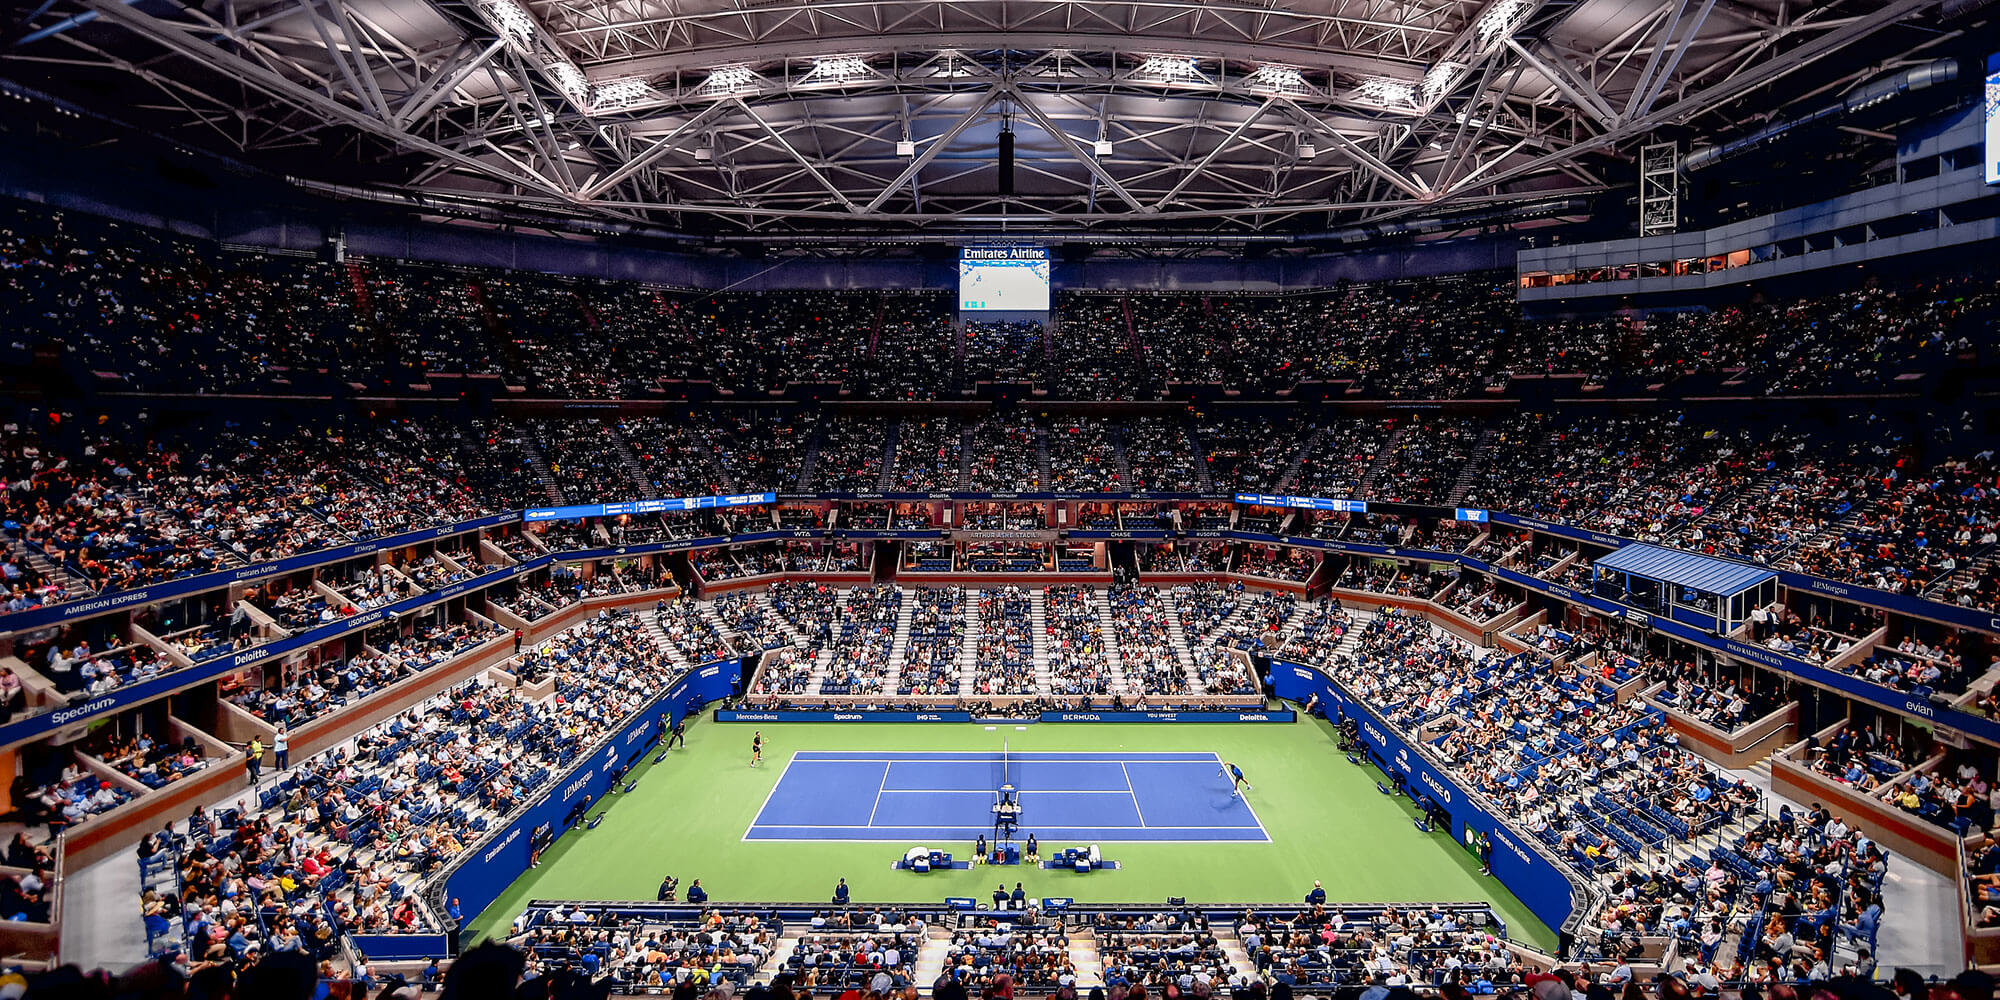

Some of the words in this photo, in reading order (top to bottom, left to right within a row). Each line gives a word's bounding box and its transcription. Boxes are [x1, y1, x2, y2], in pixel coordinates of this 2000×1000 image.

[964, 248, 1008, 259] Emirates
[1010, 248, 1045, 259] Airline
[436, 526, 454, 536] CHASE
[236, 568, 260, 579] Emirates
[260, 564, 278, 576] Airline
[1548, 585, 1572, 598] BERMUDA
[1811, 580, 1848, 596] J.P.Morgan
[65, 599, 110, 616] AMERICAN
[111, 591, 148, 605] EXPRESS
[348, 610, 382, 628] USOPEN.ORG
[234, 648, 270, 666] Deloitte.
[1726, 642, 1742, 654] POLO
[1741, 647, 1761, 661] RALPH
[1760, 653, 1783, 667] LAUREN
[52, 698, 116, 724] Spectrum
[1905, 700, 1934, 718] evian
[1364, 721, 1382, 743] CHASE
[1421, 770, 1444, 798] CHASE
